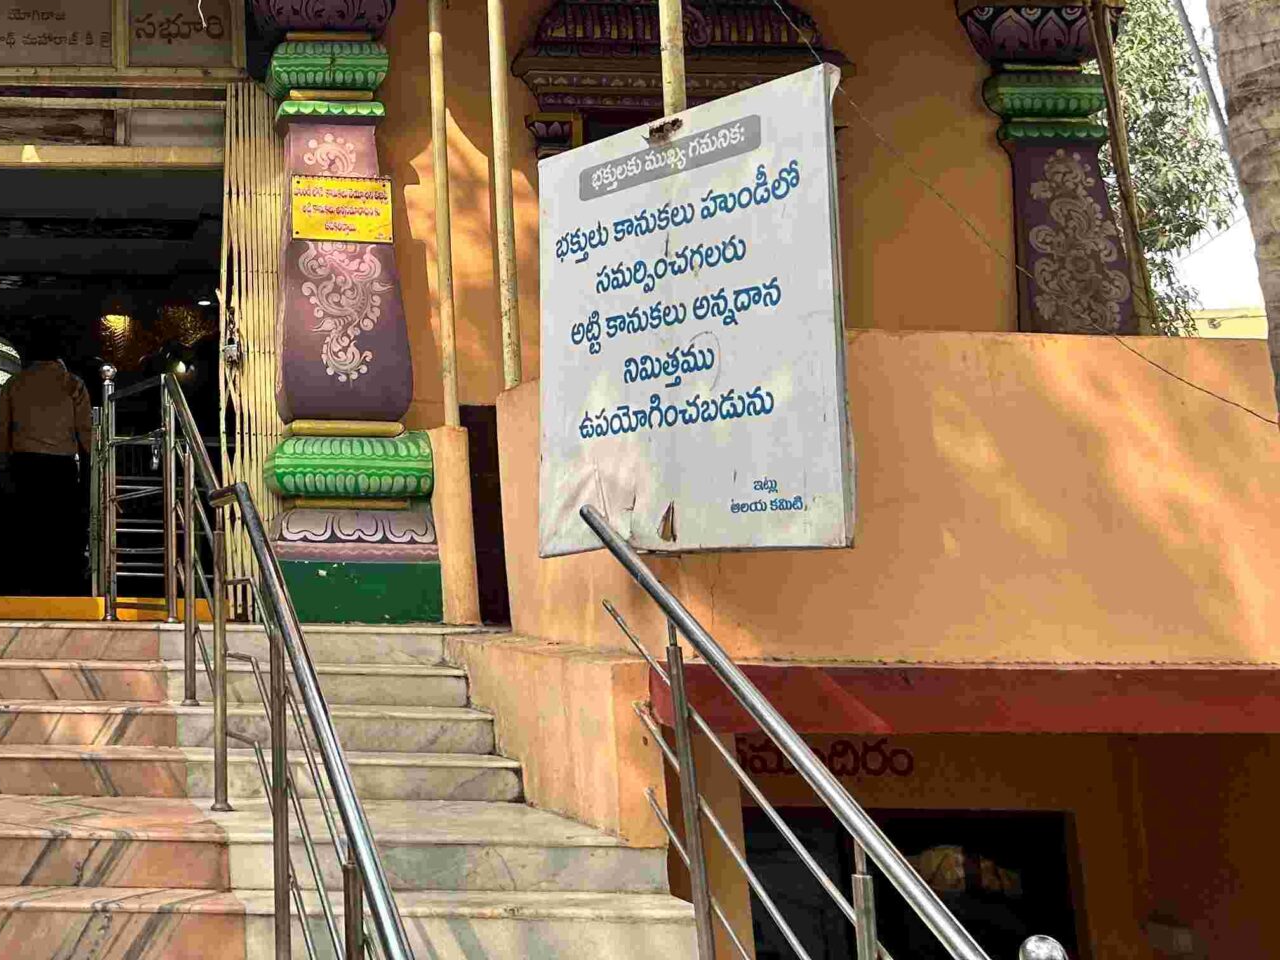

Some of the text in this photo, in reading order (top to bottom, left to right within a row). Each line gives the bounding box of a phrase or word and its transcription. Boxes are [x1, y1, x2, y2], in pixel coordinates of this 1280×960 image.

[591, 156, 642, 191] భక్తులకు
[645, 148, 687, 169] ముఖ్య
[556, 159, 801, 264] భక్తులు కానుకలు హుండీలో
[595, 235, 747, 294] సమర్పించగలరు
[571, 276, 782, 355] అట్టి కానుకలు అన్నదాన
[623, 343, 715, 389] నిమిత్తము
[578, 386, 775, 439] ఉపయోగించబడును
